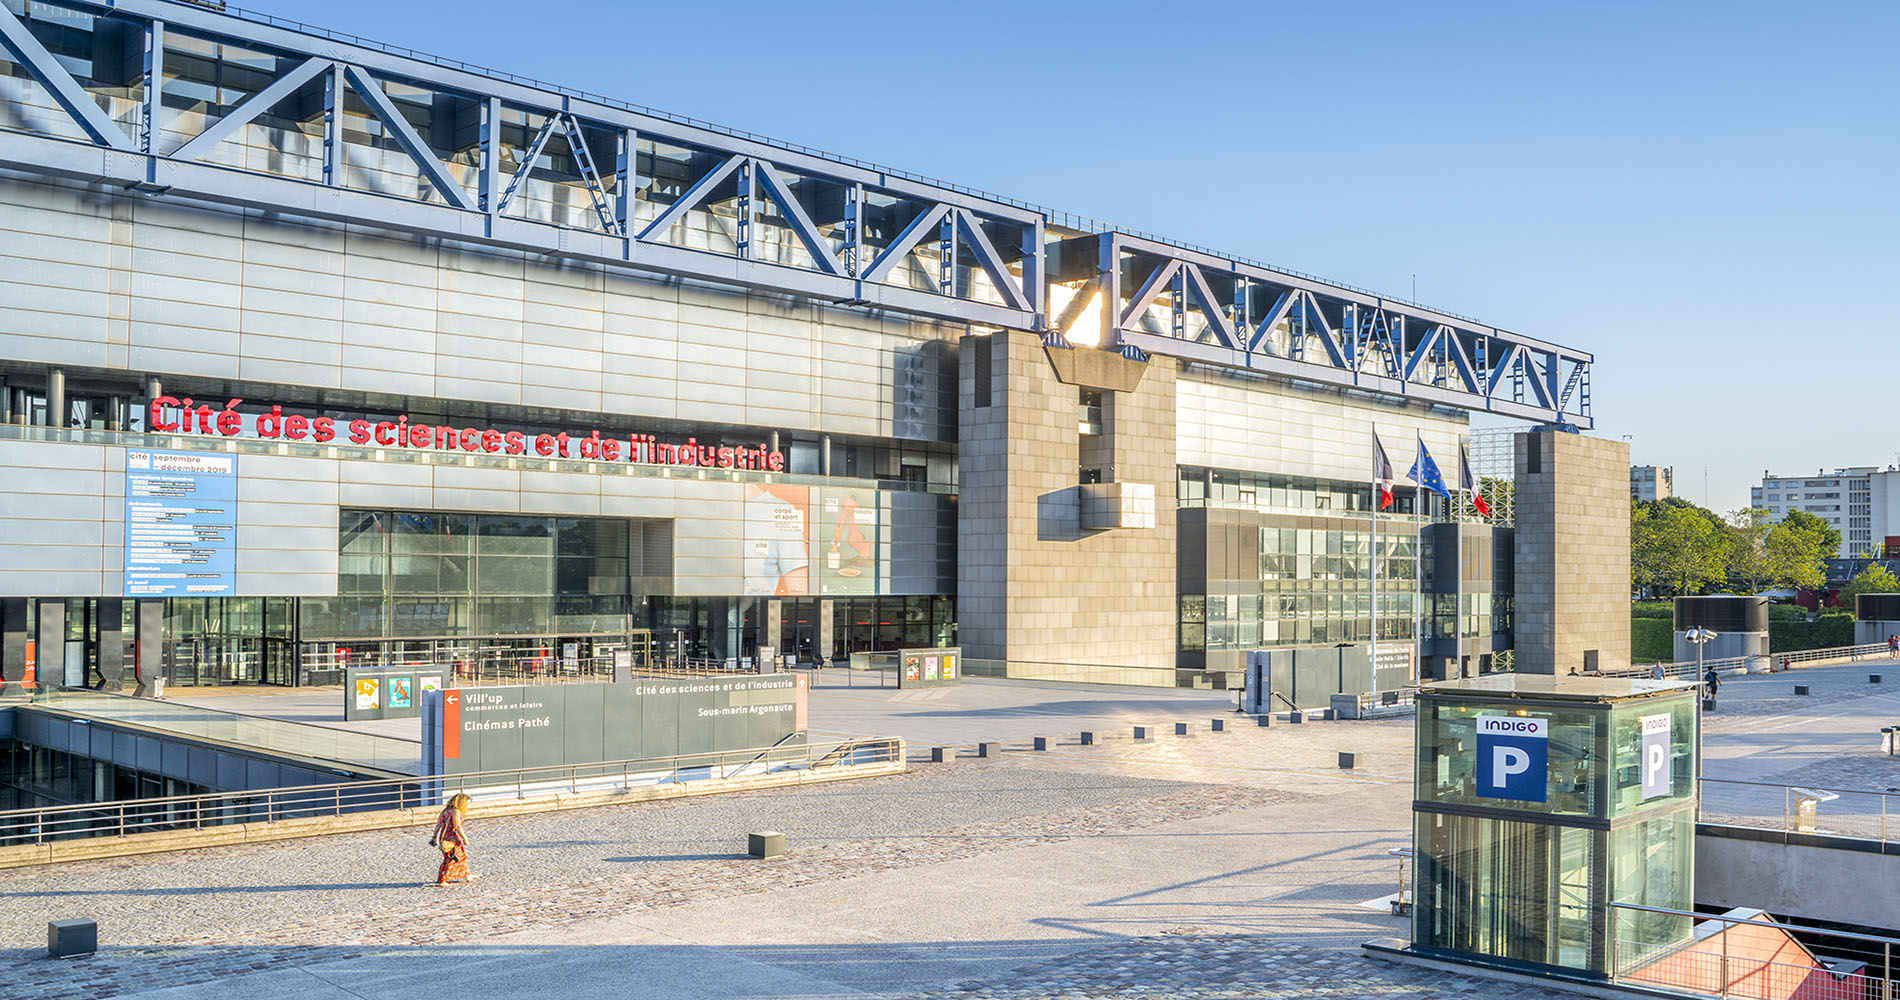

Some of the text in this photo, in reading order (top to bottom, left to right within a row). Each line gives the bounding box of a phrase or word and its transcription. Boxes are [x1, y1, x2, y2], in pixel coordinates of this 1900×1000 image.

[151, 395, 785, 471] Cité des sciences et de l'industrie
[154, 454, 201, 463] septembre
[161, 464, 205, 473] décembre
[207, 466, 227, 474] 2019
[636, 680, 793, 695] Cité des sciences et de l'industrie
[698, 704, 793, 717] Sous-marin Argonaute
[464, 716, 550, 731] Cinémas Pathé
[1485, 720, 1538, 733] INDIGO
[1493, 745, 1530, 788] P
[1648, 743, 1665, 787] P
